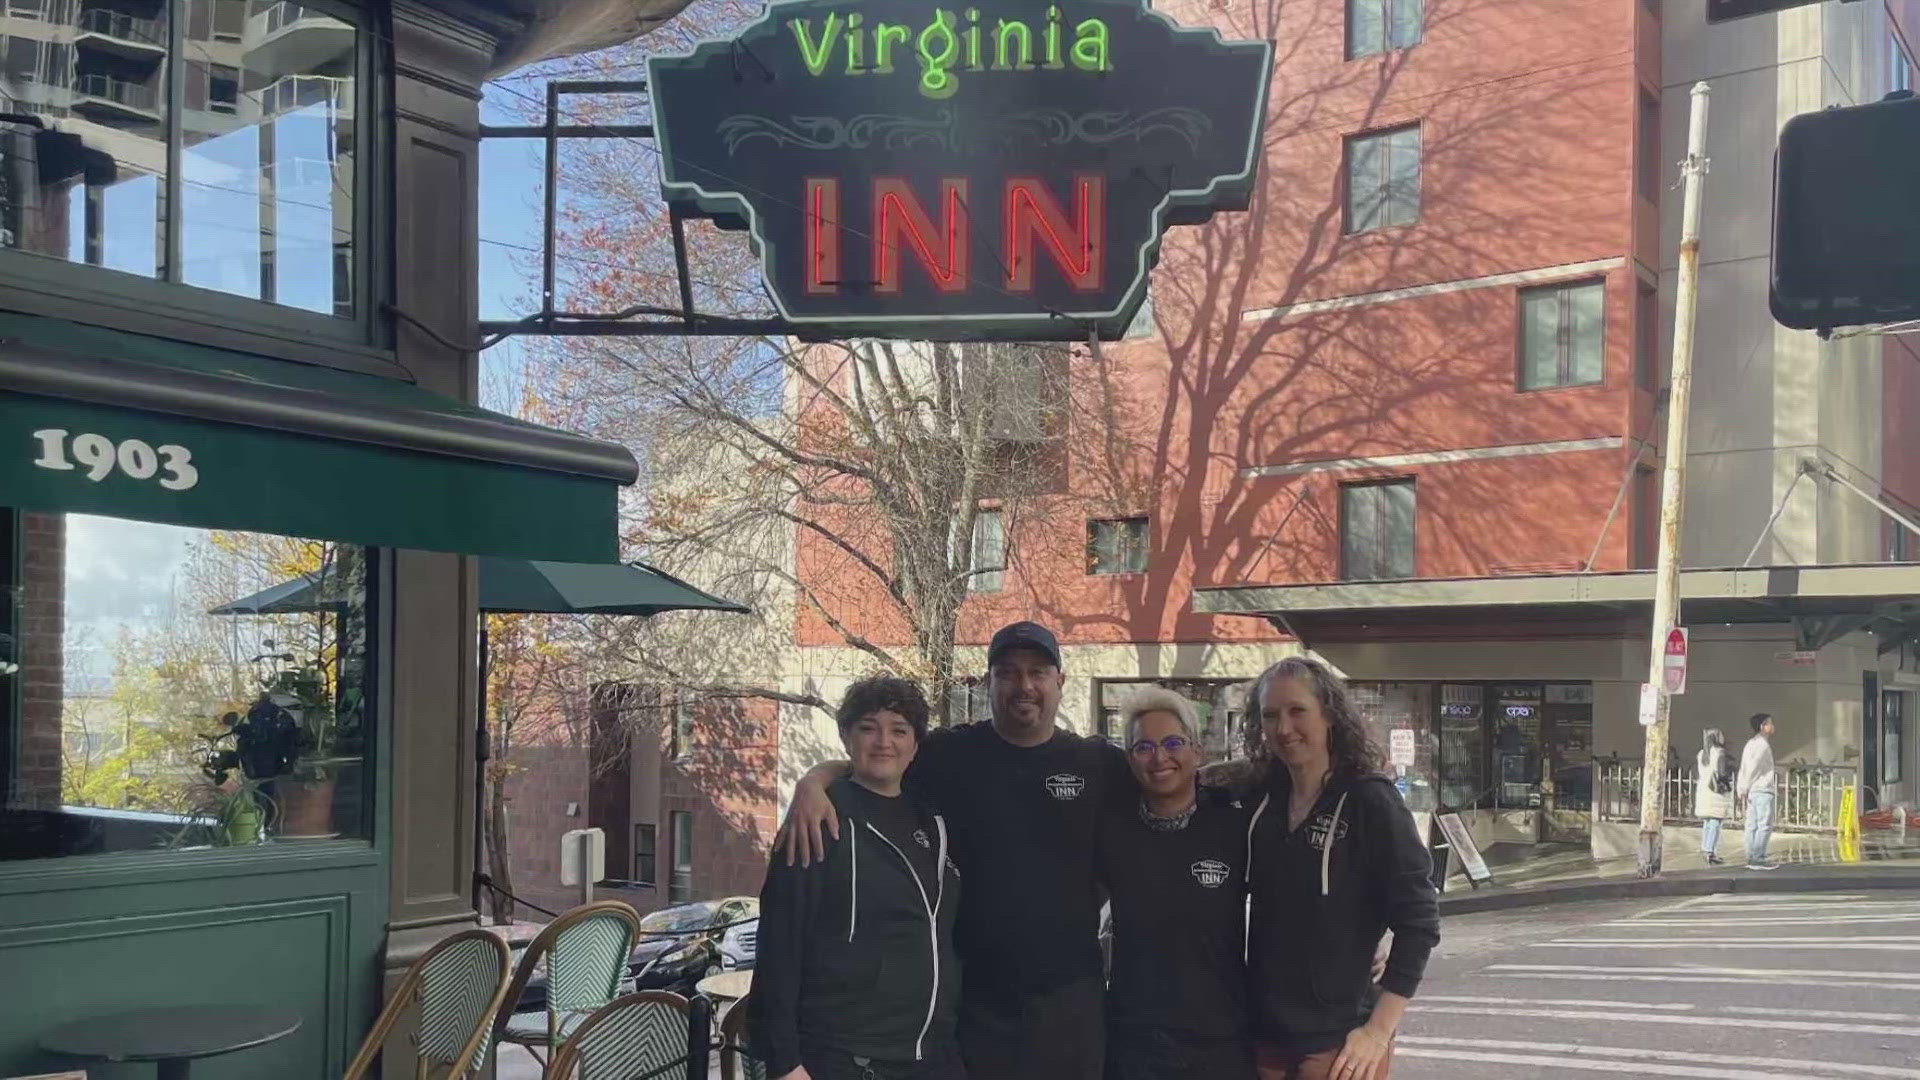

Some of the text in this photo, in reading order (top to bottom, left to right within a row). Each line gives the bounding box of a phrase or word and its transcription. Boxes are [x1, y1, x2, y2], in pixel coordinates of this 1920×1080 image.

[788, 5, 1113, 99] Virginia
[803, 177, 1104, 293] INN
[33, 428, 199, 490] 1903
[1055, 786, 1076, 797] INN
[1202, 873, 1220, 883] INN
